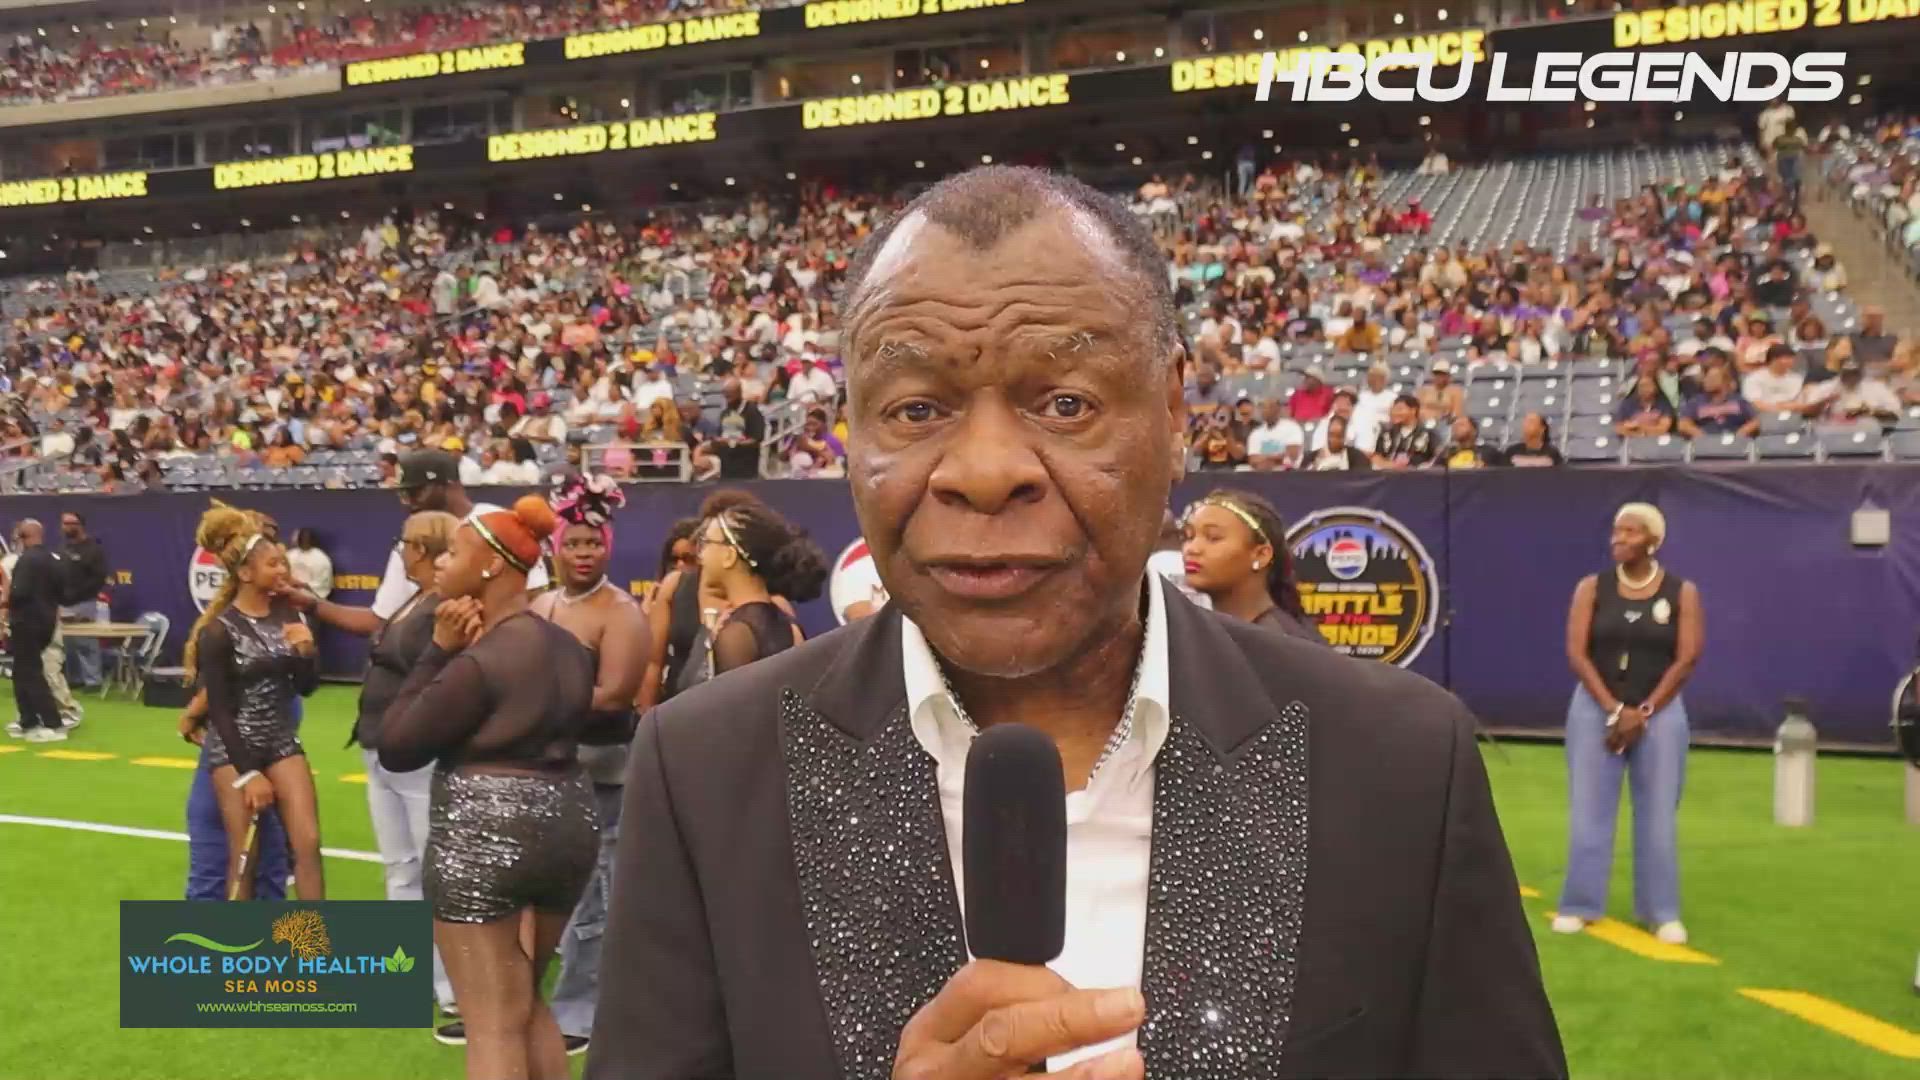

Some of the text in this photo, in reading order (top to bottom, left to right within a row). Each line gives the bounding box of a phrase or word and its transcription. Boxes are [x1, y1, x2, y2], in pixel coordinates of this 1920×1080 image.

[564, 11, 761, 60] DESIGNED 2 DANCE
[1614, 0, 1808, 48] DESIGNED
[1814, 0, 1842, 27] 2
[346, 42, 525, 86] DESIGNED 2 DANCE
[802, 73, 1070, 129] DESIGNED 2 DANCE
[488, 112, 716, 161] DESIGNED 2 DANCE
[61, 177, 76, 202] 2
[77, 171, 148, 200] DANCE
[213, 144, 414, 189] DESIGNED 2 DANCE
